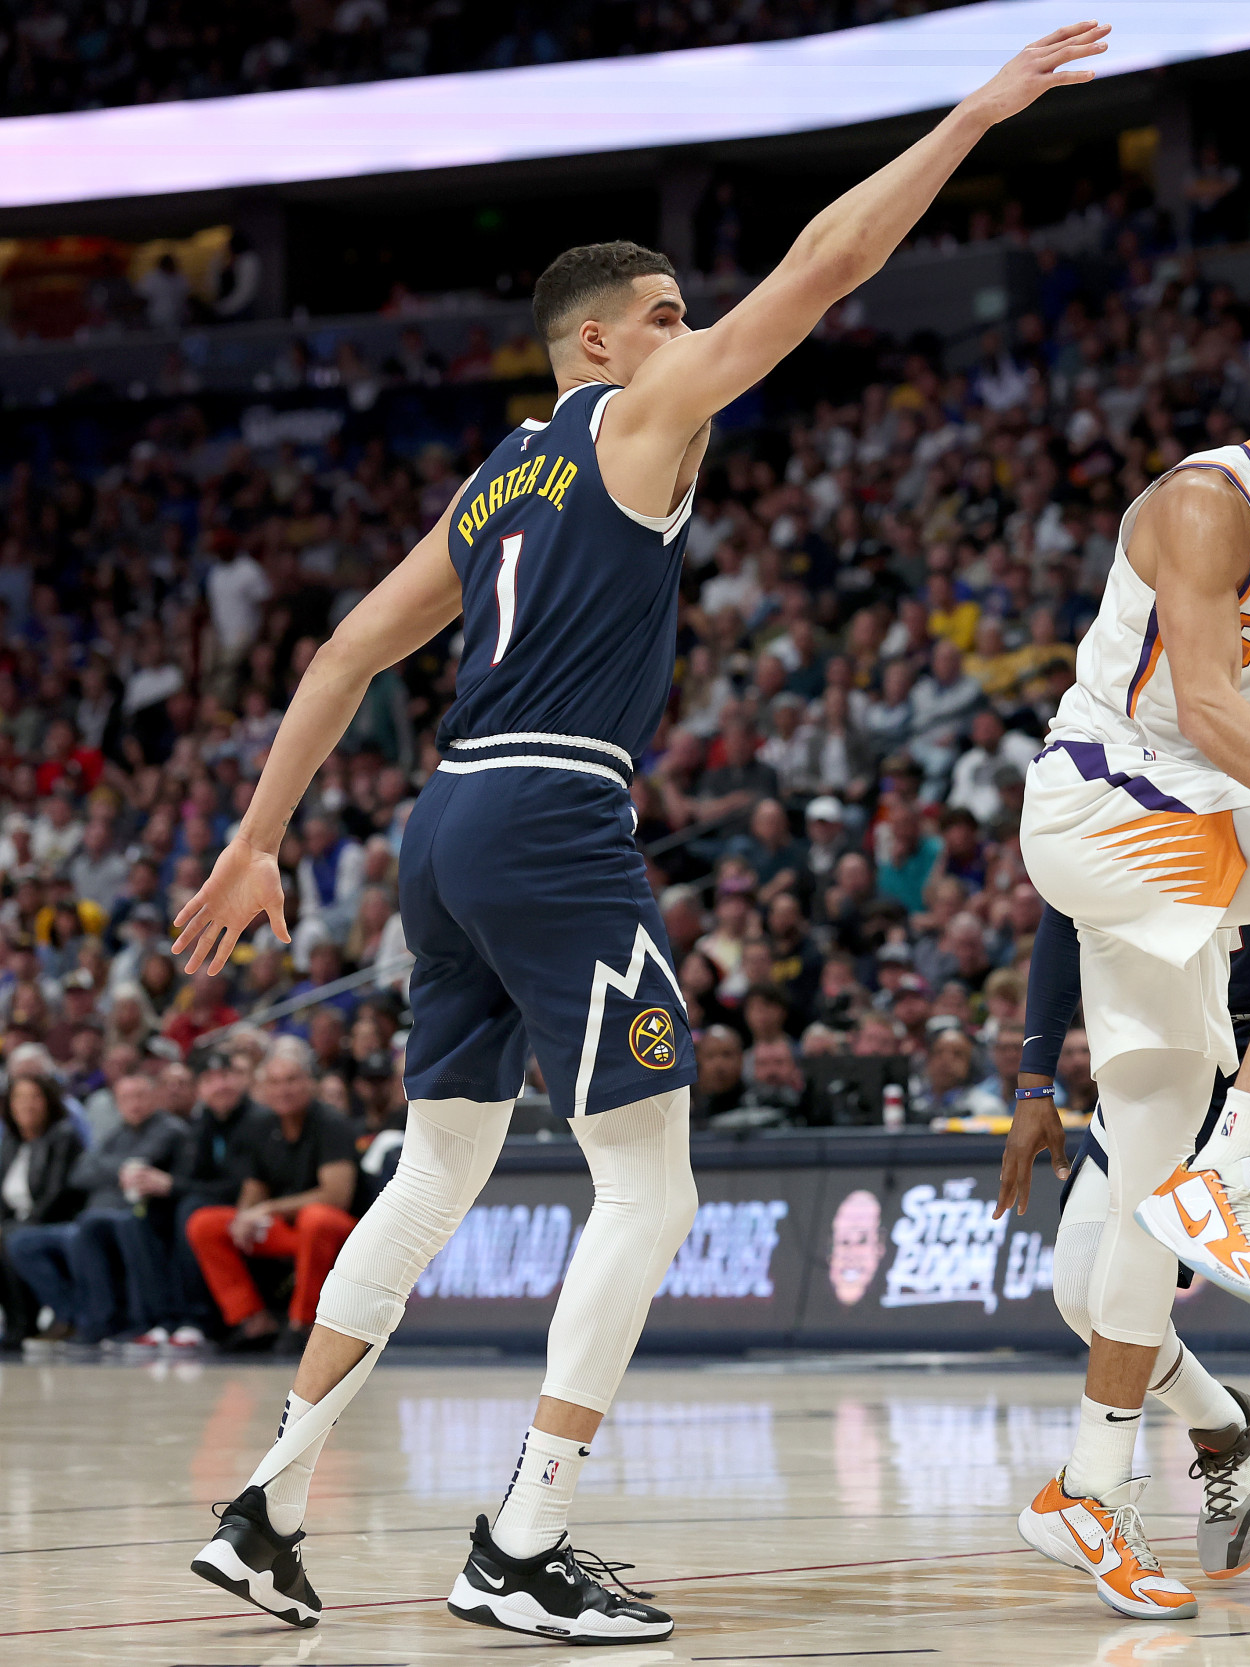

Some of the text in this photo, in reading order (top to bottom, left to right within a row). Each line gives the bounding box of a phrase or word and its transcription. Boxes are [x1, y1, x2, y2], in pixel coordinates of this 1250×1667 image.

[457, 454, 578, 547] PORTER JR.
[490, 530, 524, 667] 1
